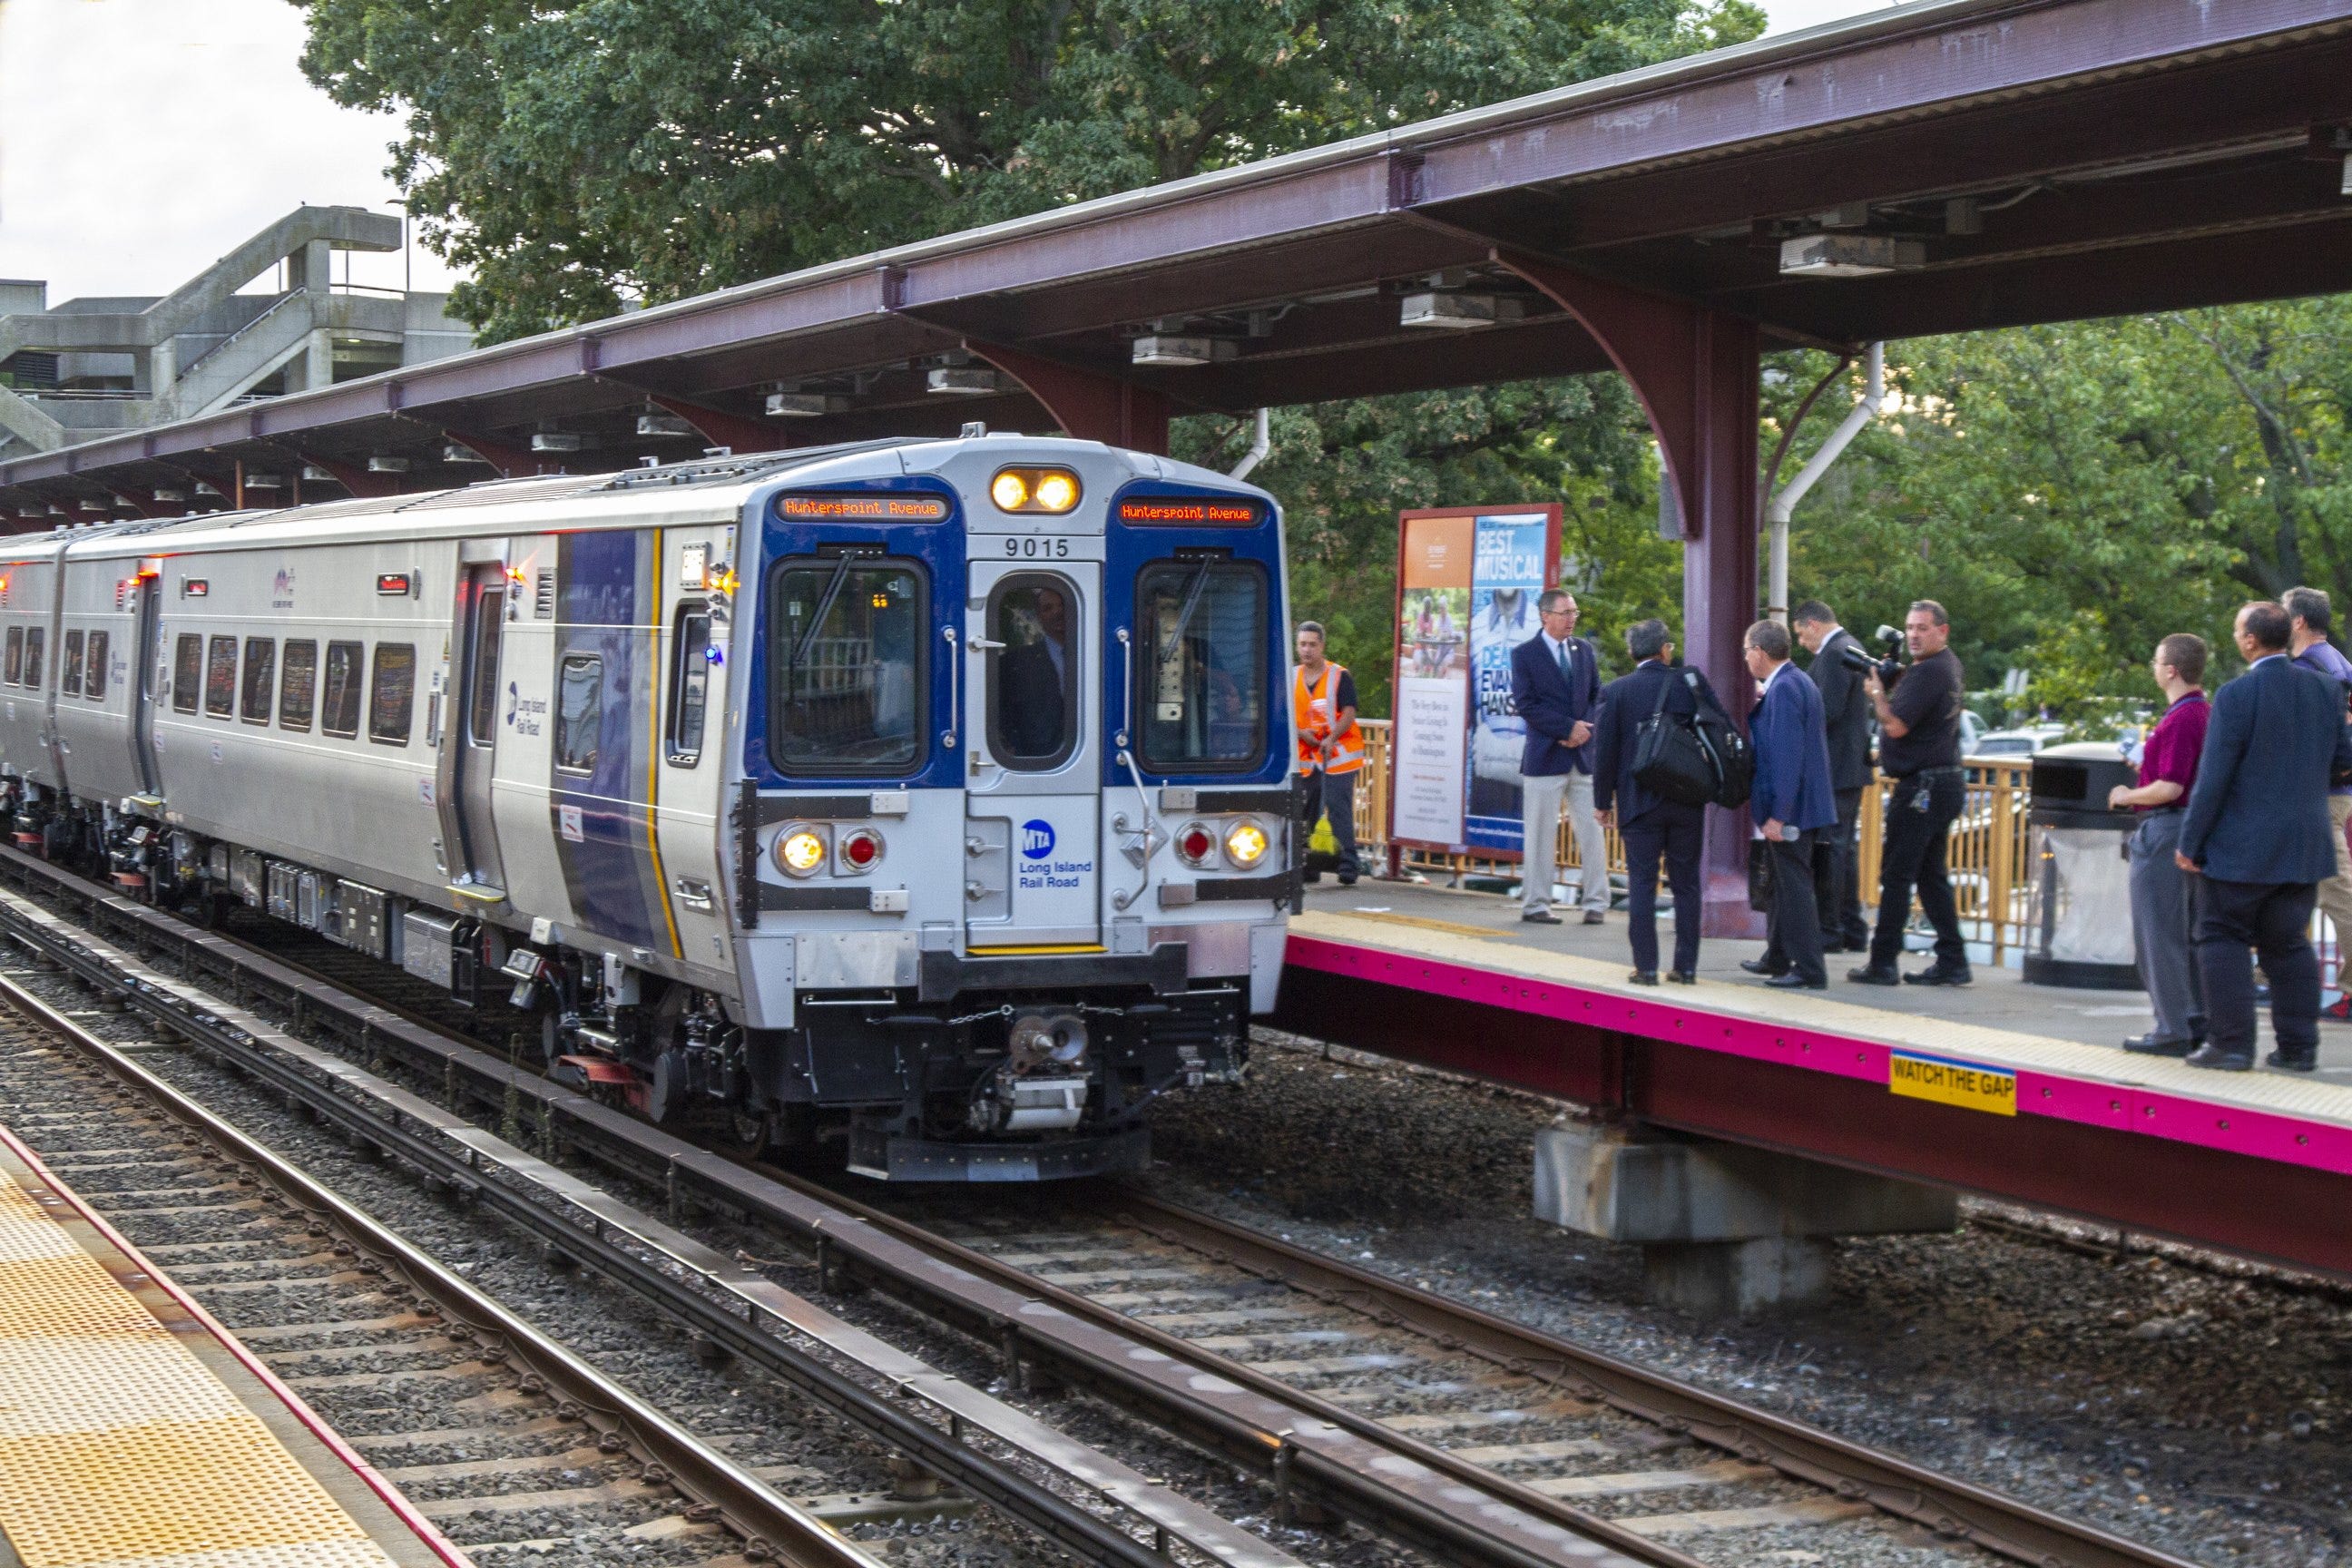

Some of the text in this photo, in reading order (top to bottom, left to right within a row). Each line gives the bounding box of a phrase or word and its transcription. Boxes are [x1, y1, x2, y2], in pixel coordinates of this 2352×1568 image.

[785, 500, 938, 515] Hunterspoint Avenue
[1122, 505, 1250, 521] Hunterspoint Avenue
[1005, 537, 1068, 557] 9015
[1478, 529, 1515, 554] BEST
[1476, 554, 1543, 581] MUSICAL
[1481, 645, 1513, 669] DEA
[1480, 692, 1519, 716] HANS
[1021, 825, 1052, 853] MTA
[1019, 861, 1092, 875] Long Island
[1019, 877, 1079, 888] Rail Road
[1894, 1057, 2014, 1097] WATCH THE GAP
